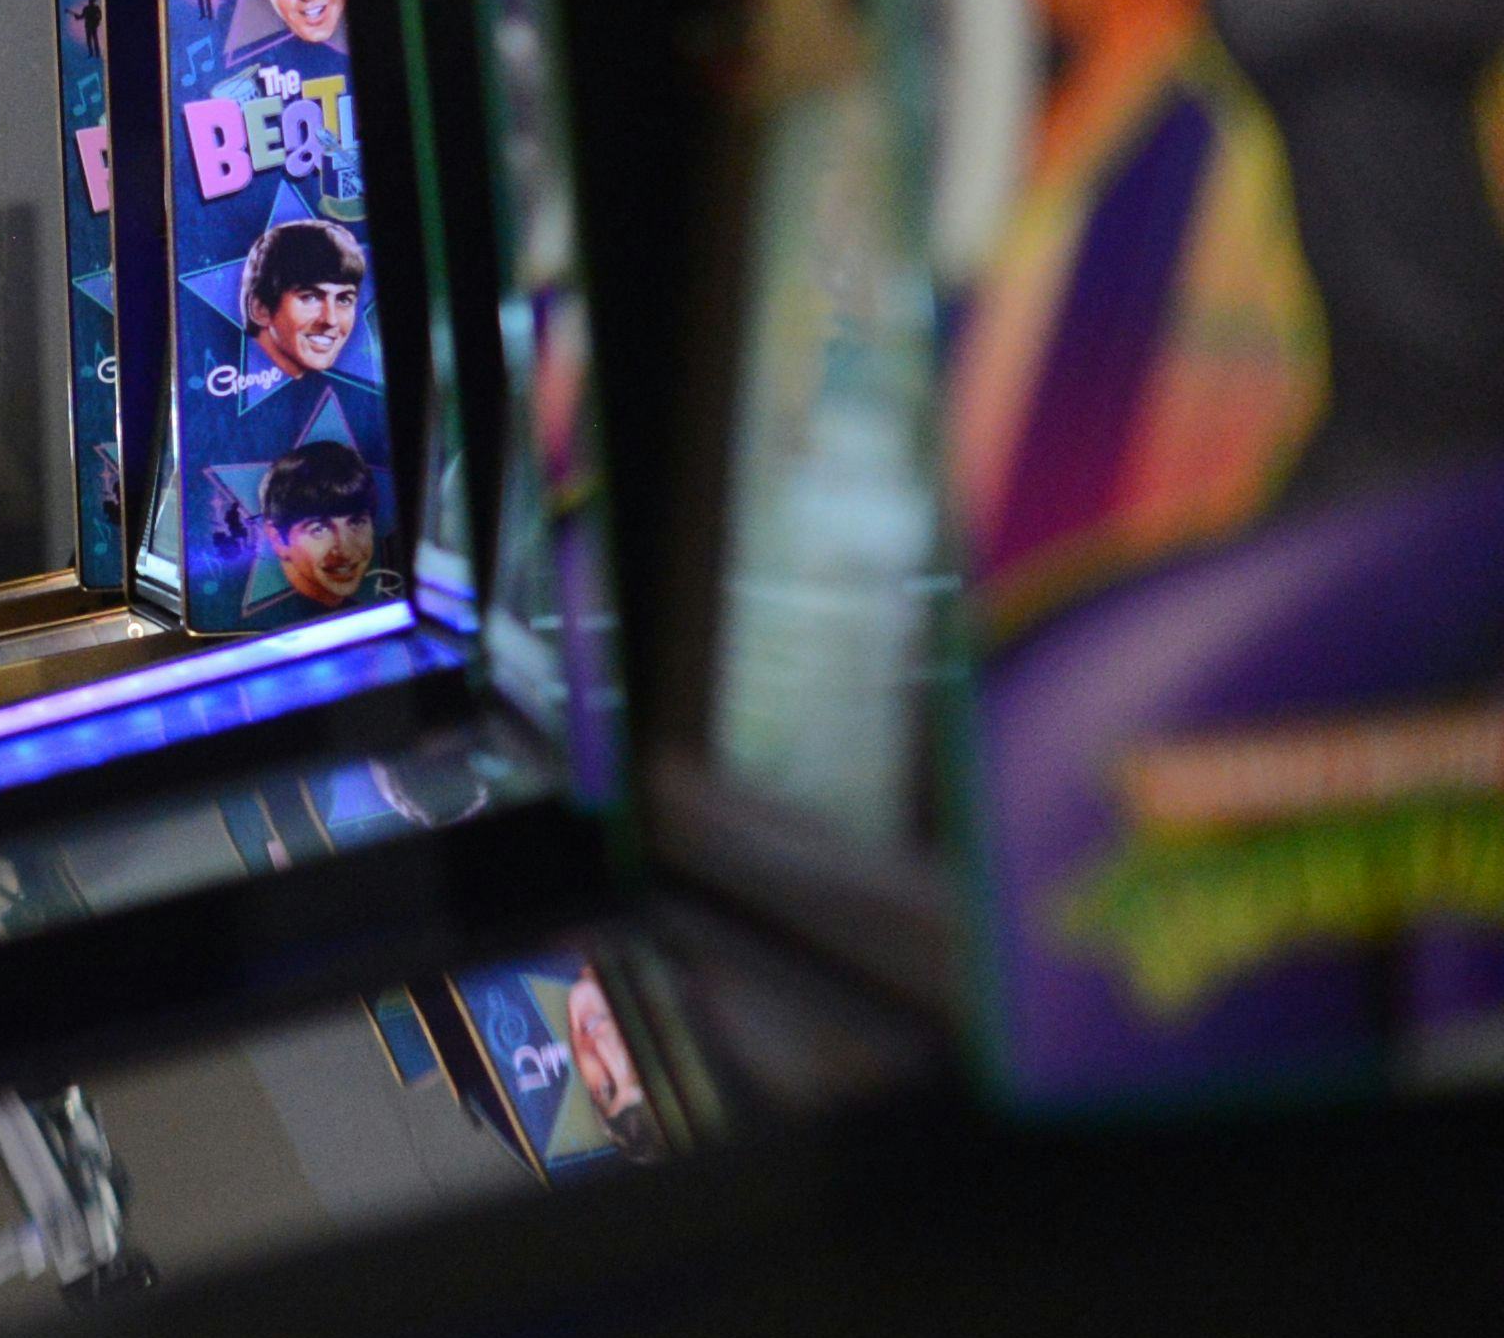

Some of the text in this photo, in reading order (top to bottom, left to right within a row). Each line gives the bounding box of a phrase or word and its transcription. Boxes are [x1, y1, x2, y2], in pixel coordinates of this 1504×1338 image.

[258, 64, 301, 99] The
[183, 74, 360, 200] BEATL
[206, 364, 283, 397] George
